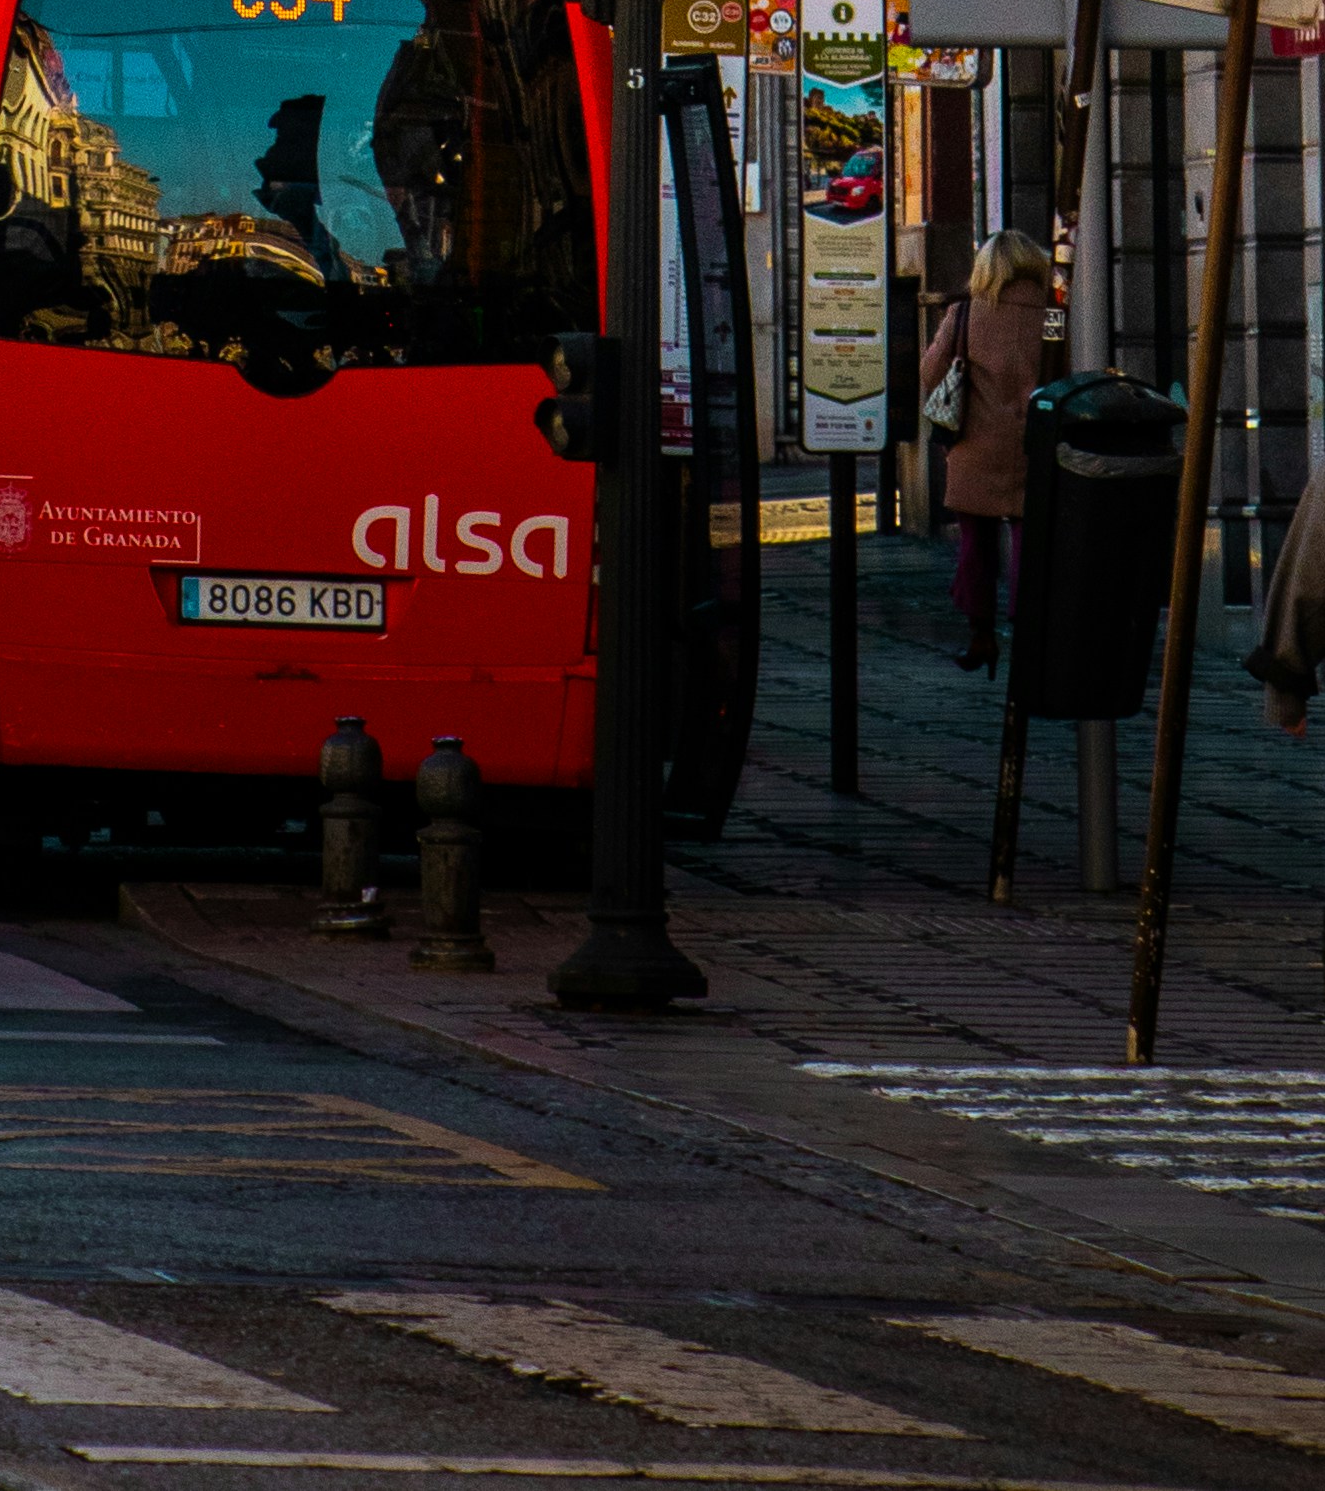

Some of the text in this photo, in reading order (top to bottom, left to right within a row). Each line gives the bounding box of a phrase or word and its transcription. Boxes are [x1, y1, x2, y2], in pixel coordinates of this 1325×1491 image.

[627, 68, 645, 89] 5
[352, 493, 569, 580] alsa
[207, 583, 375, 621] 8086 KBD
